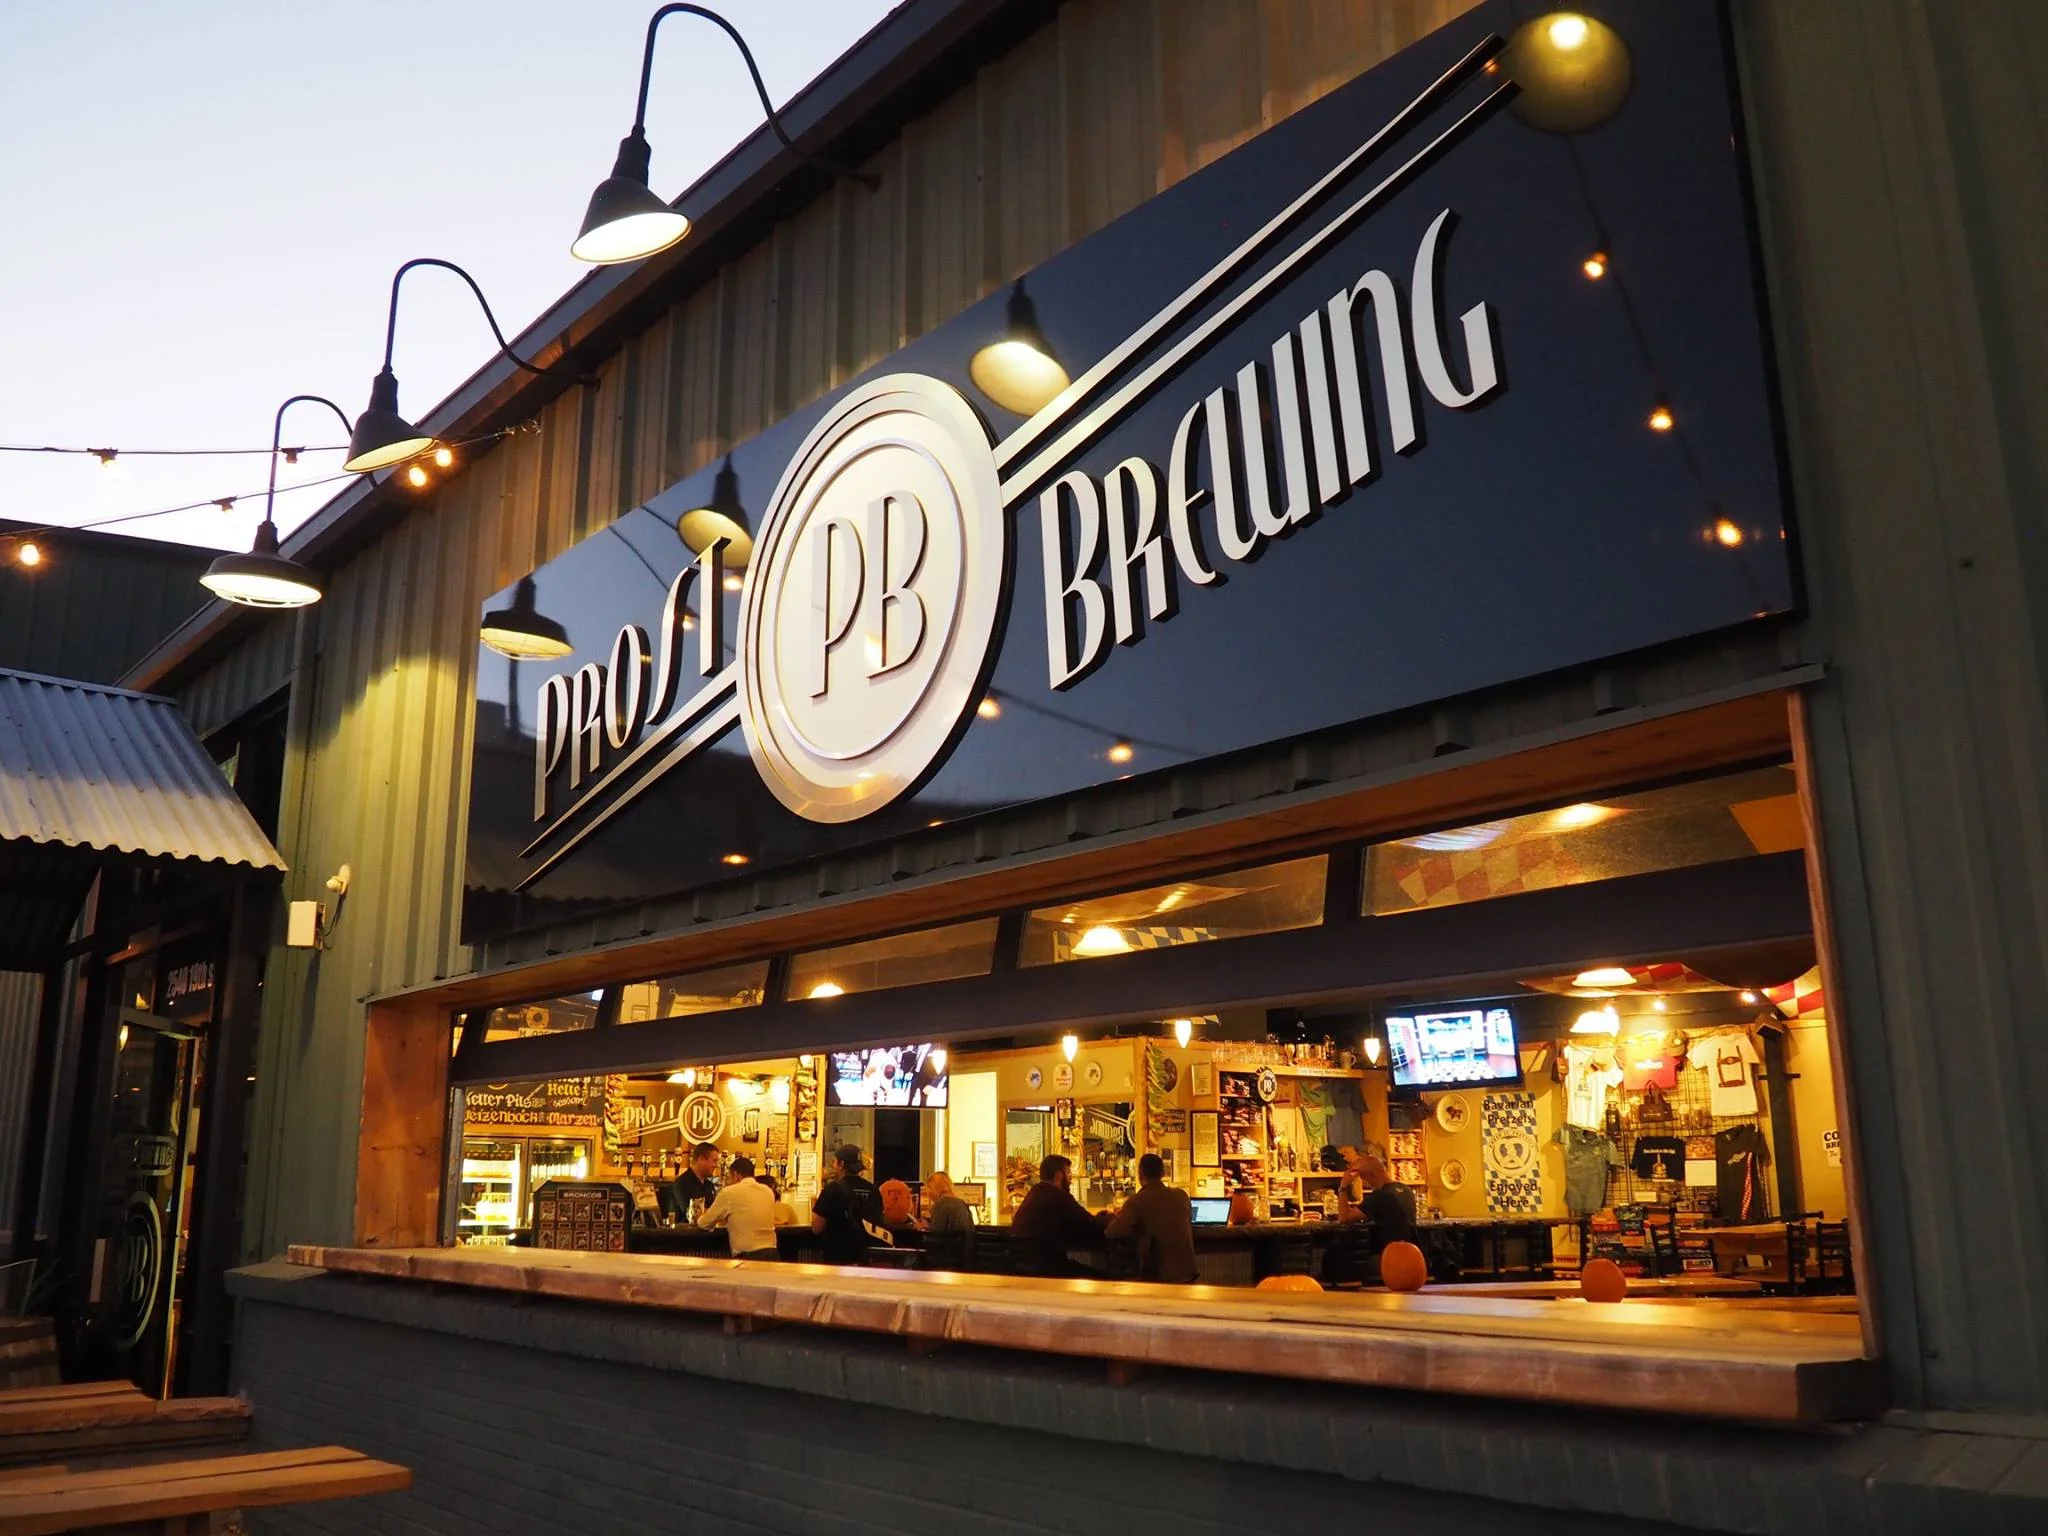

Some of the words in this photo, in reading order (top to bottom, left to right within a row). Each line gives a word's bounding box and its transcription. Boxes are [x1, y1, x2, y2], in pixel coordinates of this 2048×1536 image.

[533, 536, 731, 822] PROST
[811, 496, 927, 699] PB
[1040, 208, 1499, 690] BREWING
[1483, 1099, 1534, 1111] Bavarian
[692, 1100, 714, 1130] PB
[1487, 1114, 1532, 1125] Pretzels
[1490, 1181, 1538, 1195] Enjoyed
[563, 1191, 602, 1199] BRONCOS
[1500, 1197, 1529, 1208] Here
